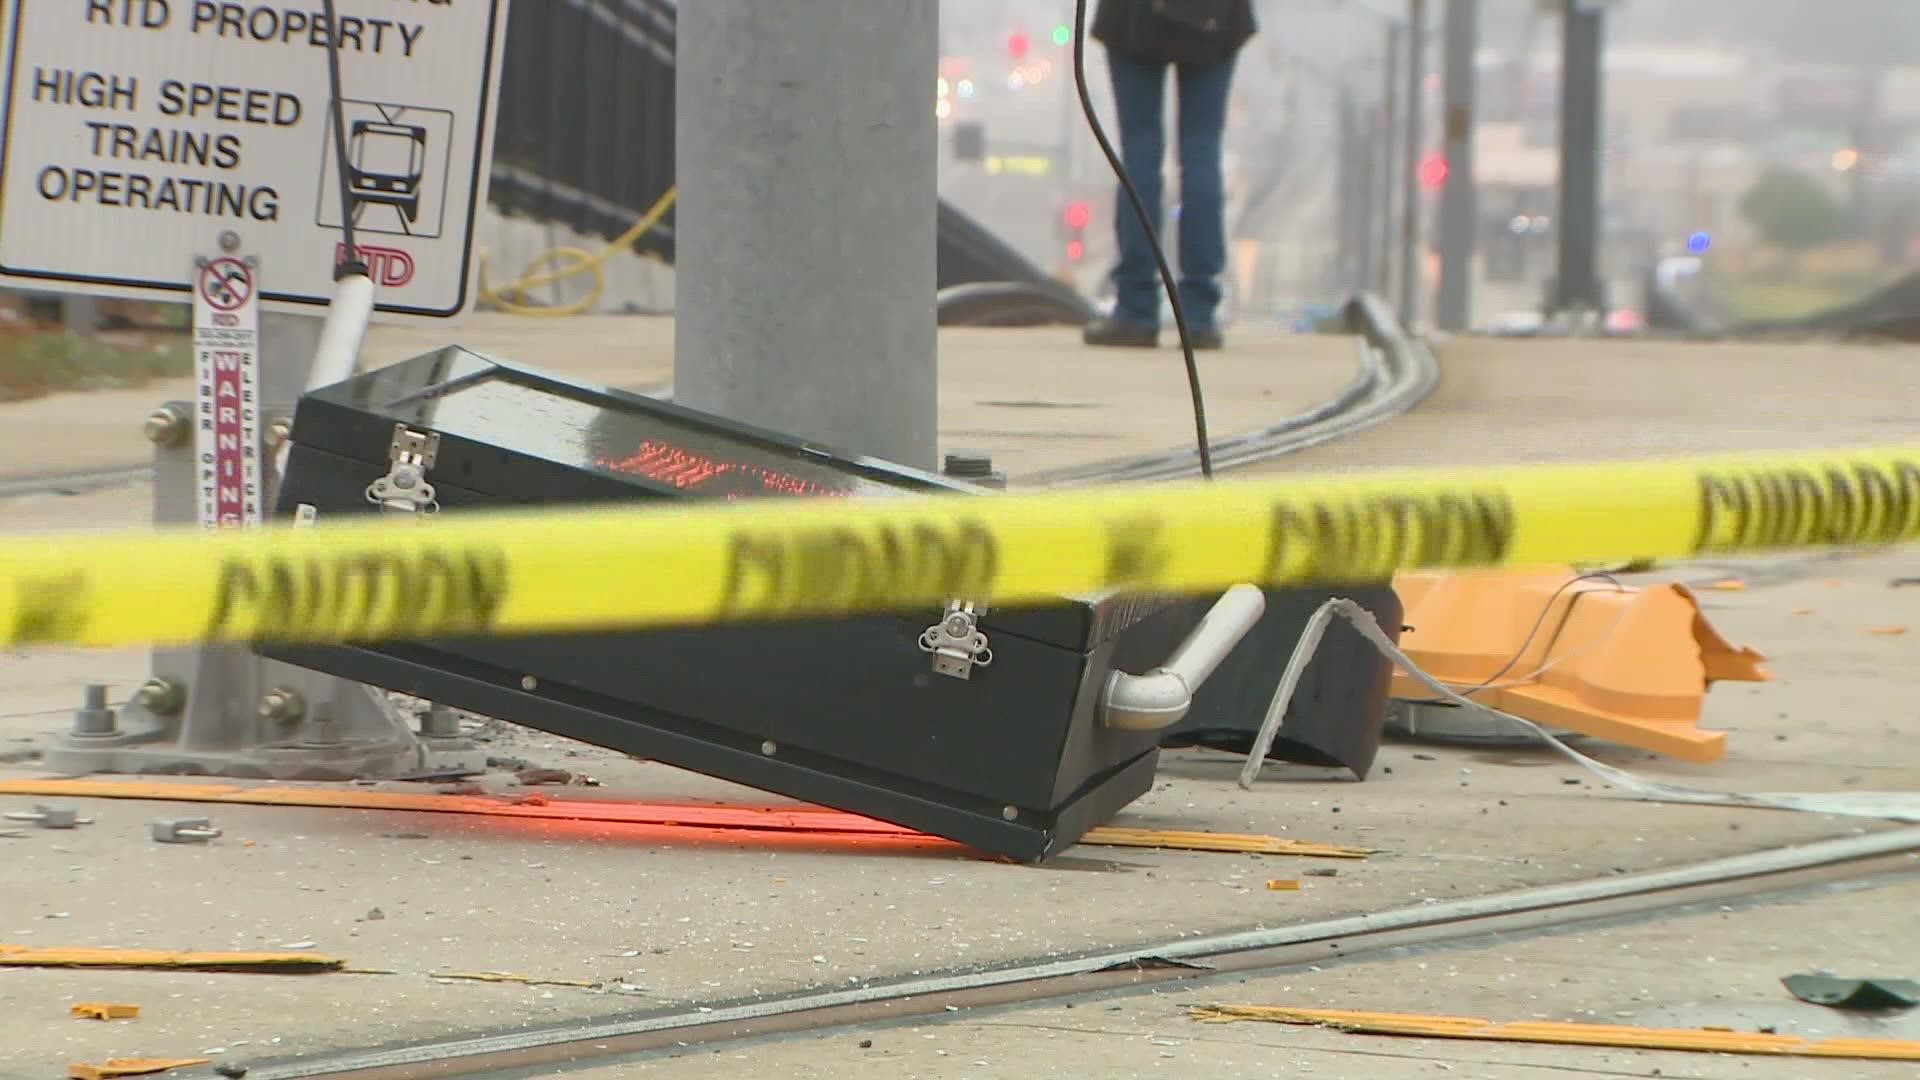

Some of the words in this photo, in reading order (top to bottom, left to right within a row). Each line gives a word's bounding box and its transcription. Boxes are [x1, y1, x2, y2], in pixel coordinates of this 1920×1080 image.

[84, 0, 168, 29] RTD
[191, 0, 423, 57] PROPERTY
[33, 67, 137, 111] HIGH
[157, 79, 301, 127] SPEED
[84, 120, 241, 169] TRAINS
[37, 165, 280, 222] OPERATING
